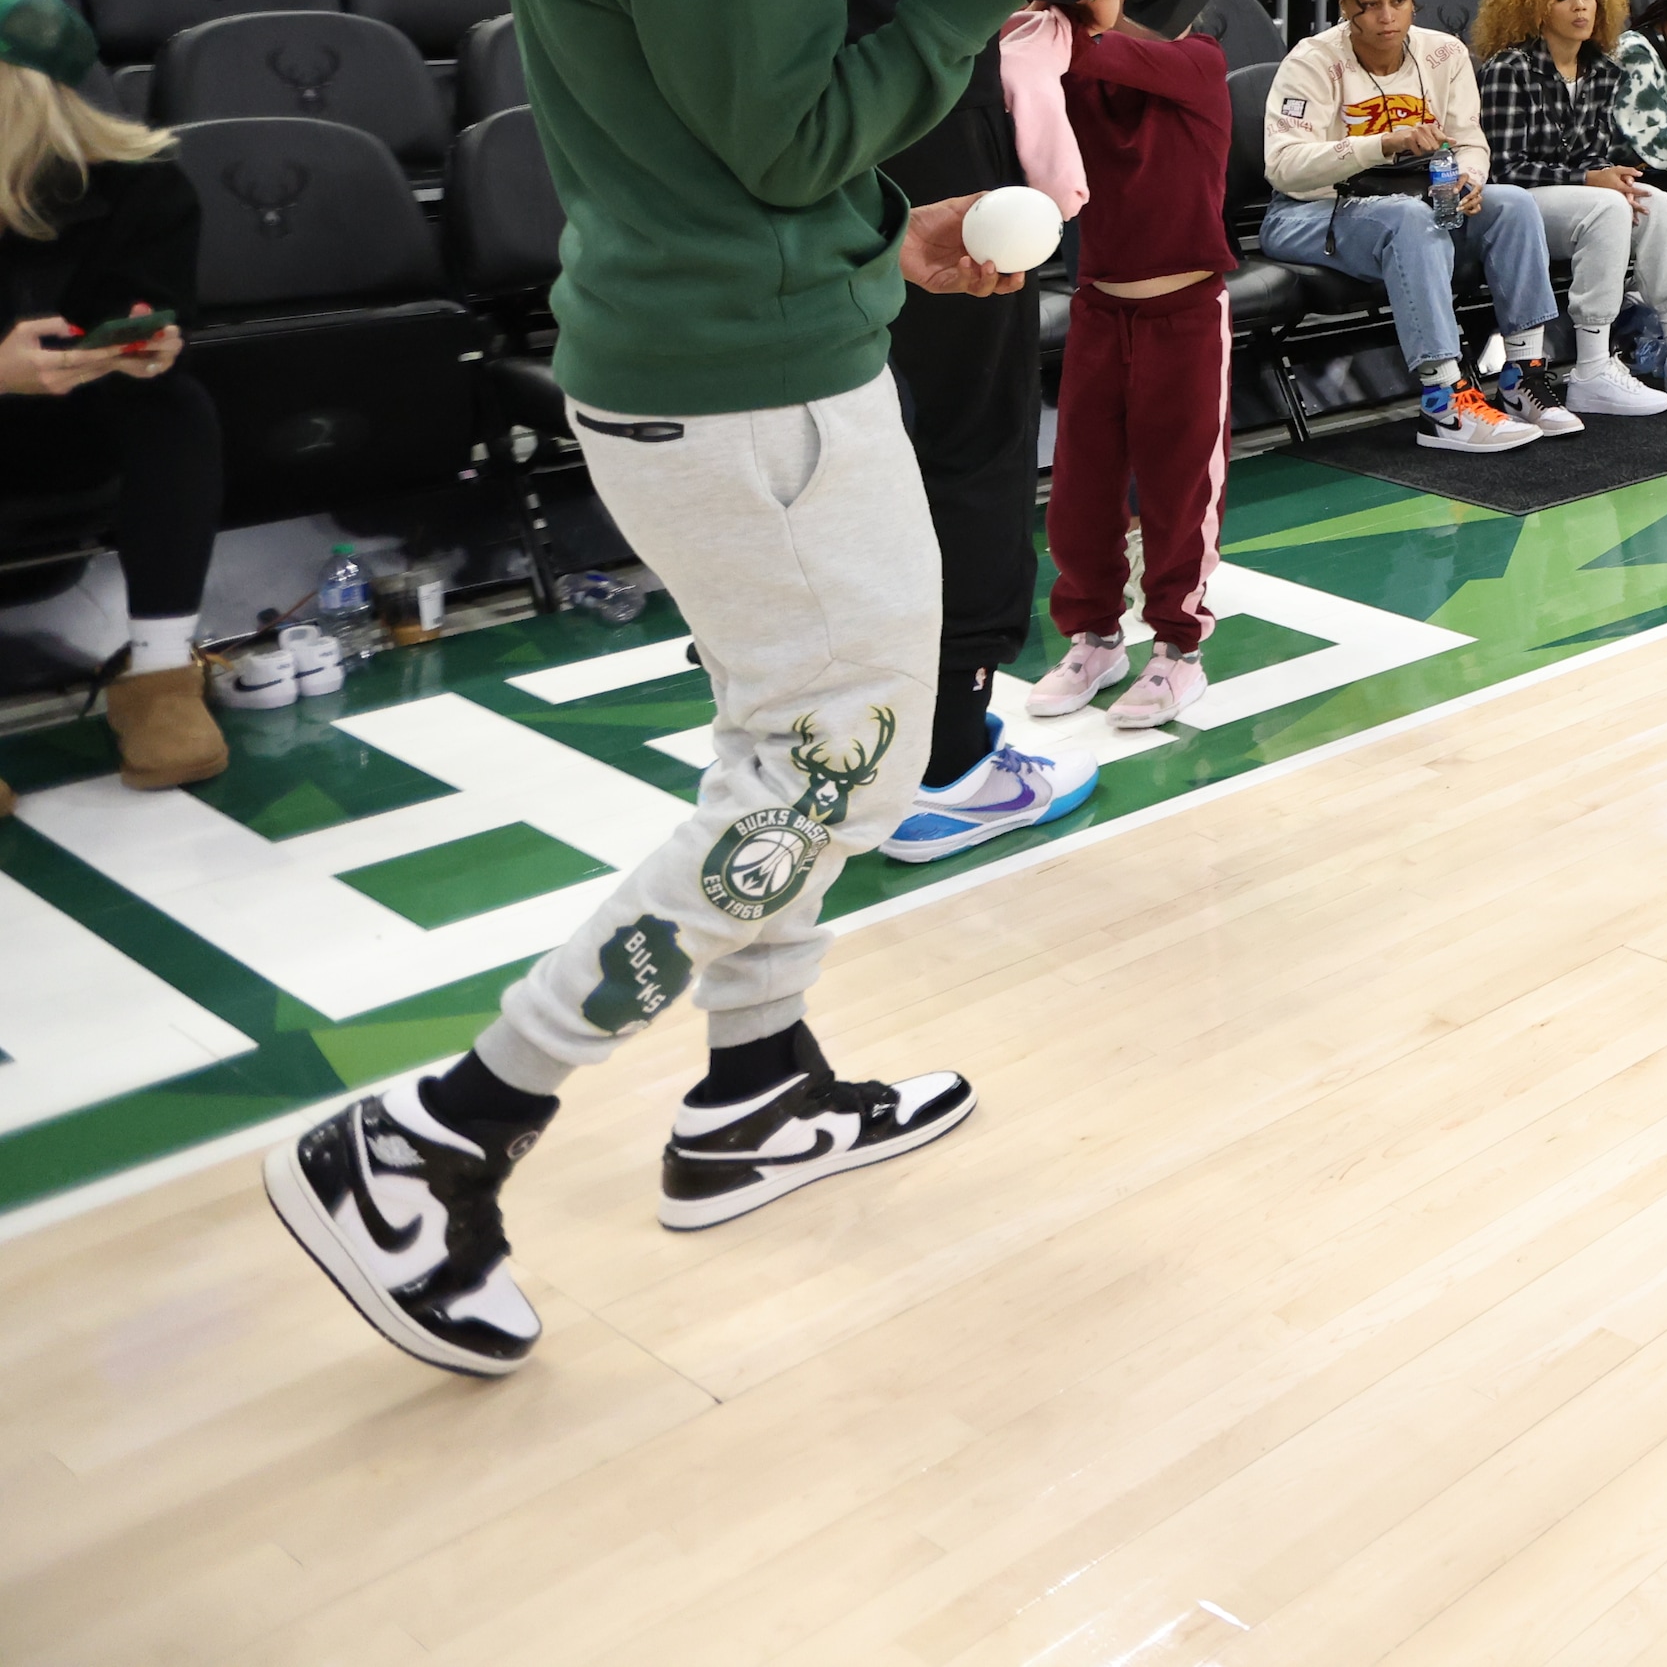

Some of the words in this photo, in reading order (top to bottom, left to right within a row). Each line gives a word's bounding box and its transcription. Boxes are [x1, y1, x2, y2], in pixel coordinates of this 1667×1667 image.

[735, 810, 791, 837] BUCKS
[724, 900, 765, 920] 1968
[624, 929, 666, 1014] BUCKS
